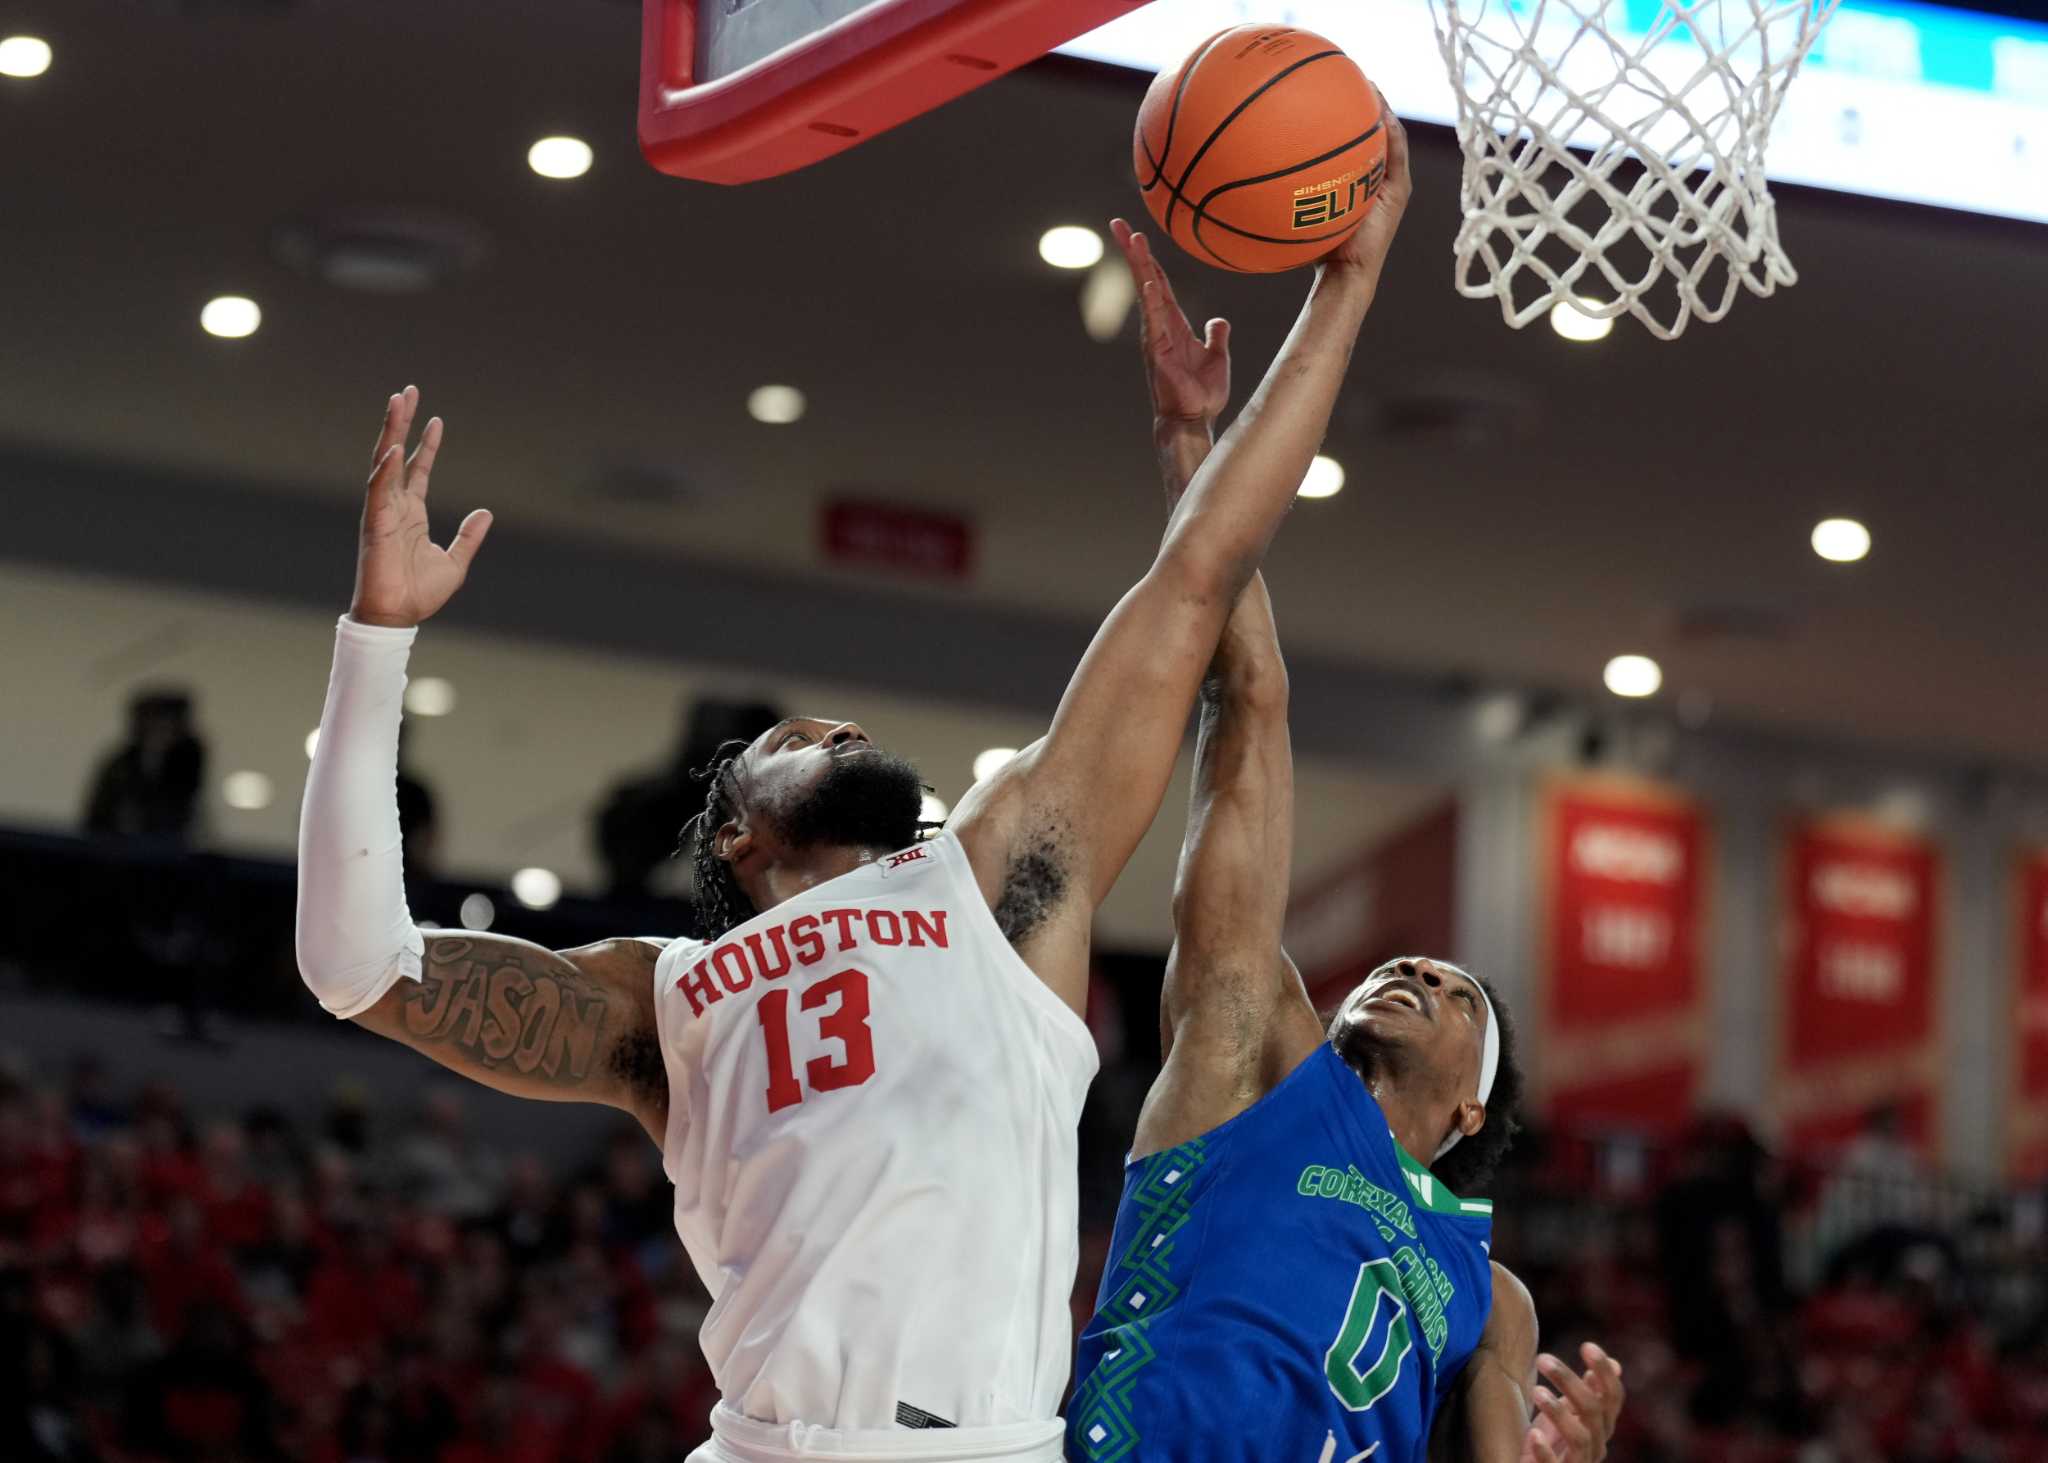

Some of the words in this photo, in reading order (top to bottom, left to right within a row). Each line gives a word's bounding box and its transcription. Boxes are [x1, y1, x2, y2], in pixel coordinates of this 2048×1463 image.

[405, 957, 607, 1078] JASON
[675, 907, 950, 1019] HOUSTON
[756, 967, 877, 1115] 13
[1324, 1257, 1413, 1413] 0
